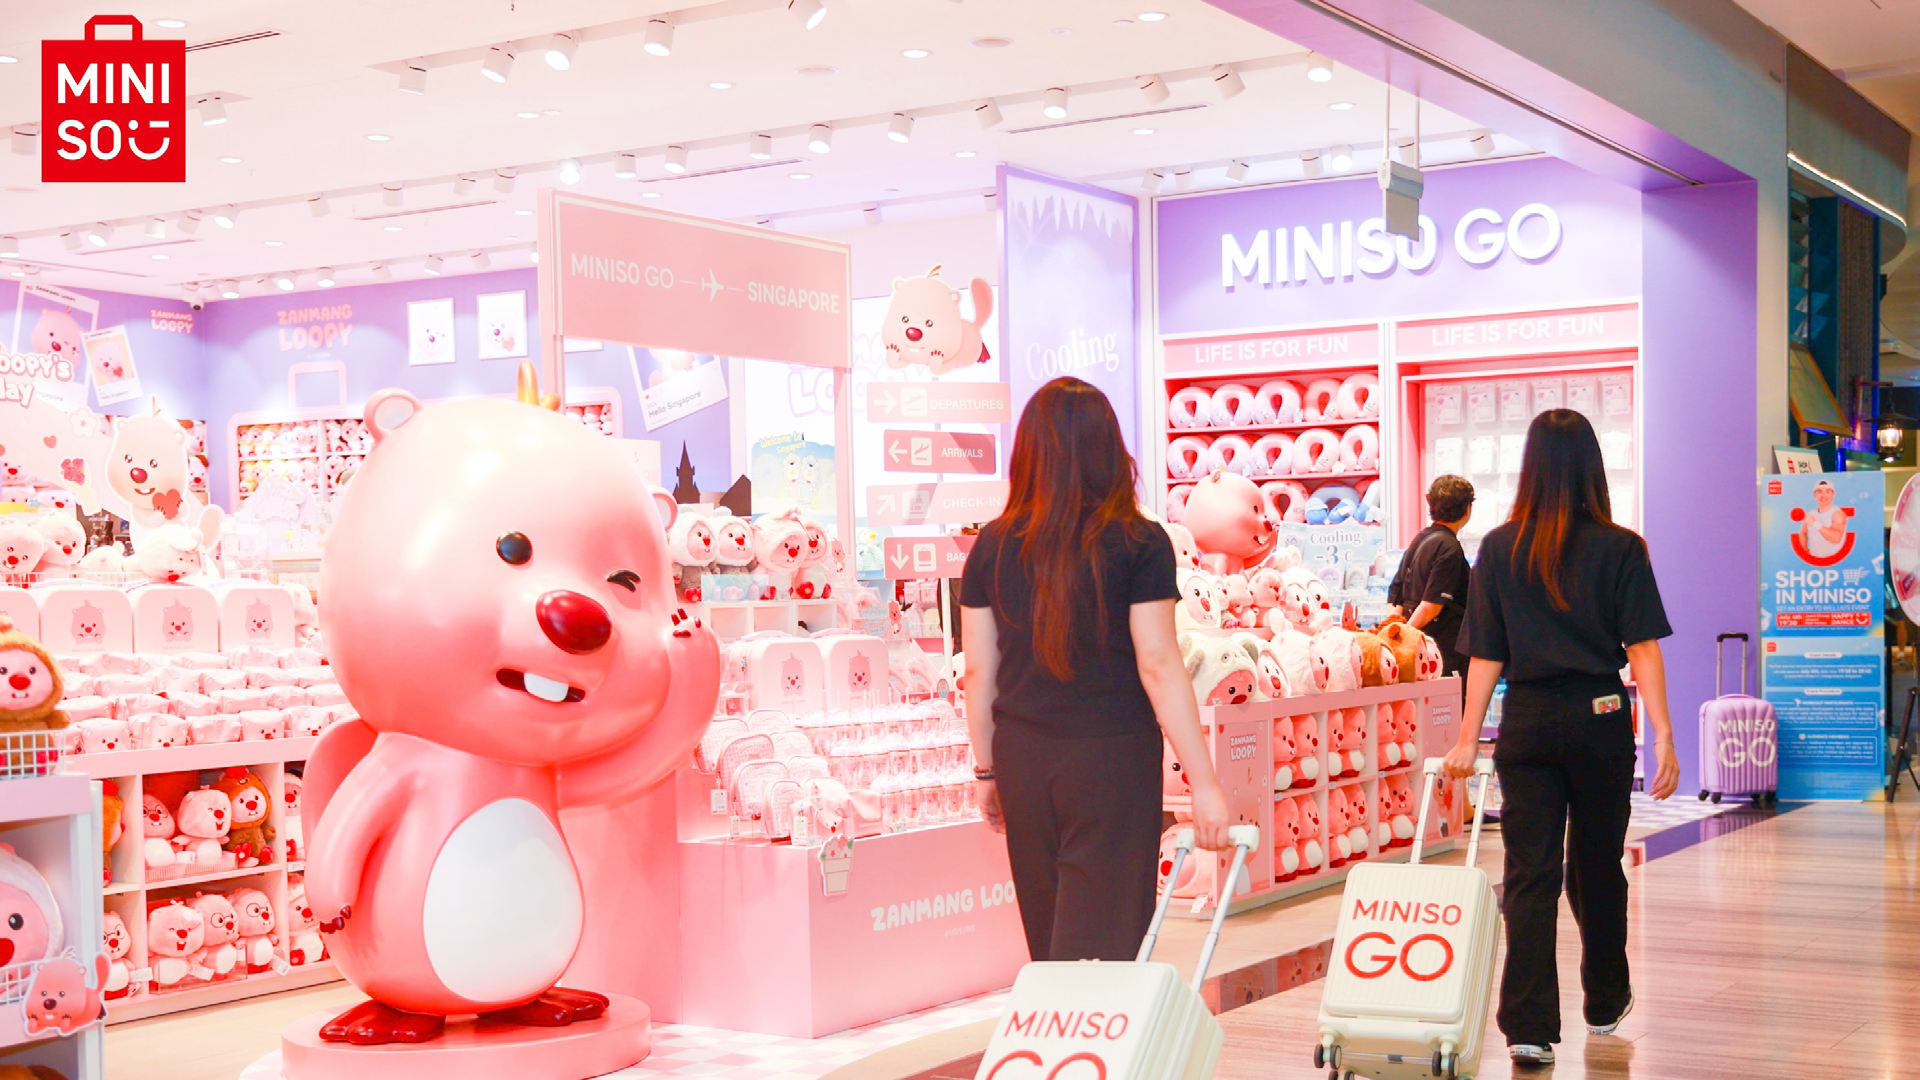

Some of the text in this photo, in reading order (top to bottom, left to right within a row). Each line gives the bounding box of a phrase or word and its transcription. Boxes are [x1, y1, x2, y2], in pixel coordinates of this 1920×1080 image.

[1221, 203, 1563, 288] MINISO GO
[571, 252, 840, 315] MINISO GO SINGAPORE
[150, 310, 193, 322] ZANMANG
[276, 303, 352, 325] ZANMANG
[151, 318, 194, 334] LOOPY
[1432, 315, 1604, 347] LIFE IS FOR FUN
[278, 322, 354, 352] LOOPY
[1026, 328, 1120, 382] Cooling
[1195, 335, 1349, 364] LIFE IS FOR FUN
[648, 405, 666, 418] Hello
[667, 390, 702, 410] Singapore
[930, 399, 1004, 410] DEPARTURES
[759, 430, 803, 449] Welcome to
[776, 441, 807, 454] Singapore
[941, 447, 983, 459] ARRIVALS
[942, 496, 1001, 509] CHECK-IN
[1310, 530, 1362, 546] Cooling
[946, 551, 969, 562] BAG
[1775, 569, 1839, 588] SHOP
[1775, 587, 1872, 604] IN MINISO
[1432, 714, 1452, 726] LOOPY
[1718, 719, 1775, 733] MINISO
[1230, 733, 1257, 746] ZANMANG
[1230, 744, 1257, 761] LOOPY
[1719, 736, 1777, 768] GO
[870, 879, 1017, 931] ZANMANG LOO
[1352, 898, 1462, 926] MINISO
[1344, 931, 1454, 982] GO
[1003, 1010, 1129, 1041] MINISO
